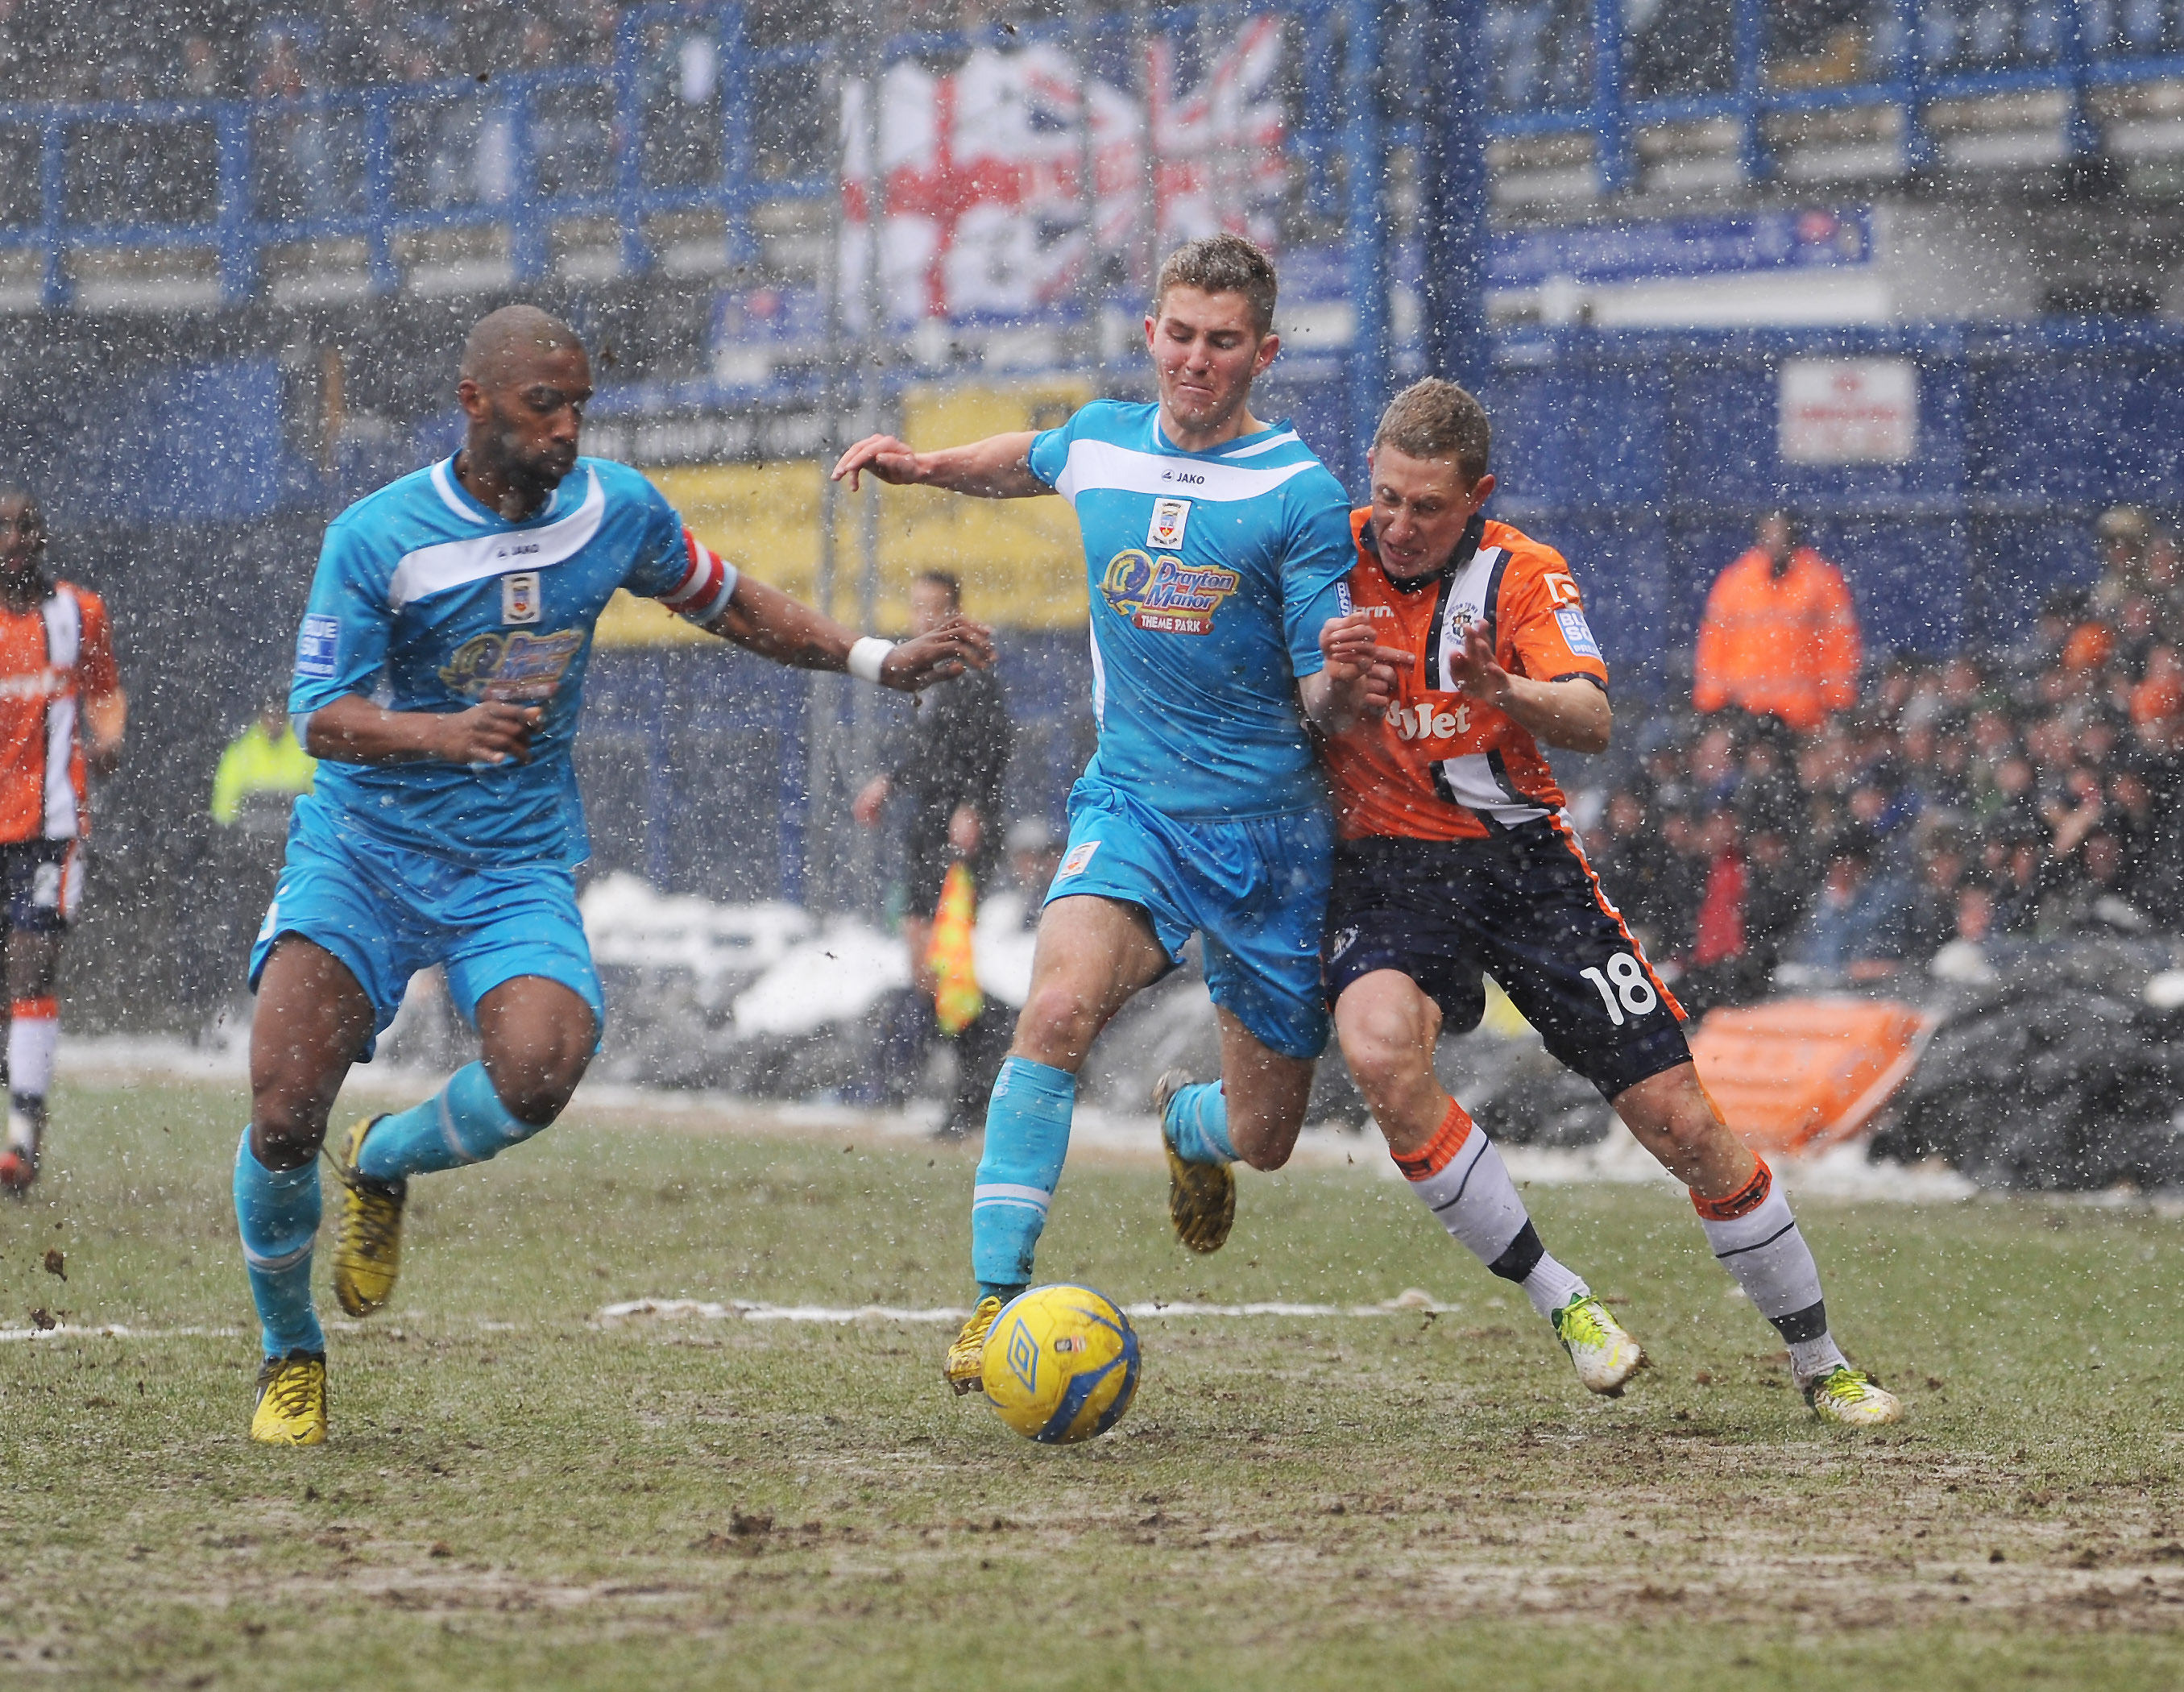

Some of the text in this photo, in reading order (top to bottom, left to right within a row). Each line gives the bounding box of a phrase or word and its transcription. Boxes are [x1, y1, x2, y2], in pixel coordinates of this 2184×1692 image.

[1176, 473, 1205, 484] JAKO
[1154, 561, 1233, 594] Drayton
[1144, 584, 1216, 608] Manor
[1141, 615, 1200, 632] THEME PARK
[1579, 952, 1657, 1026] 18
